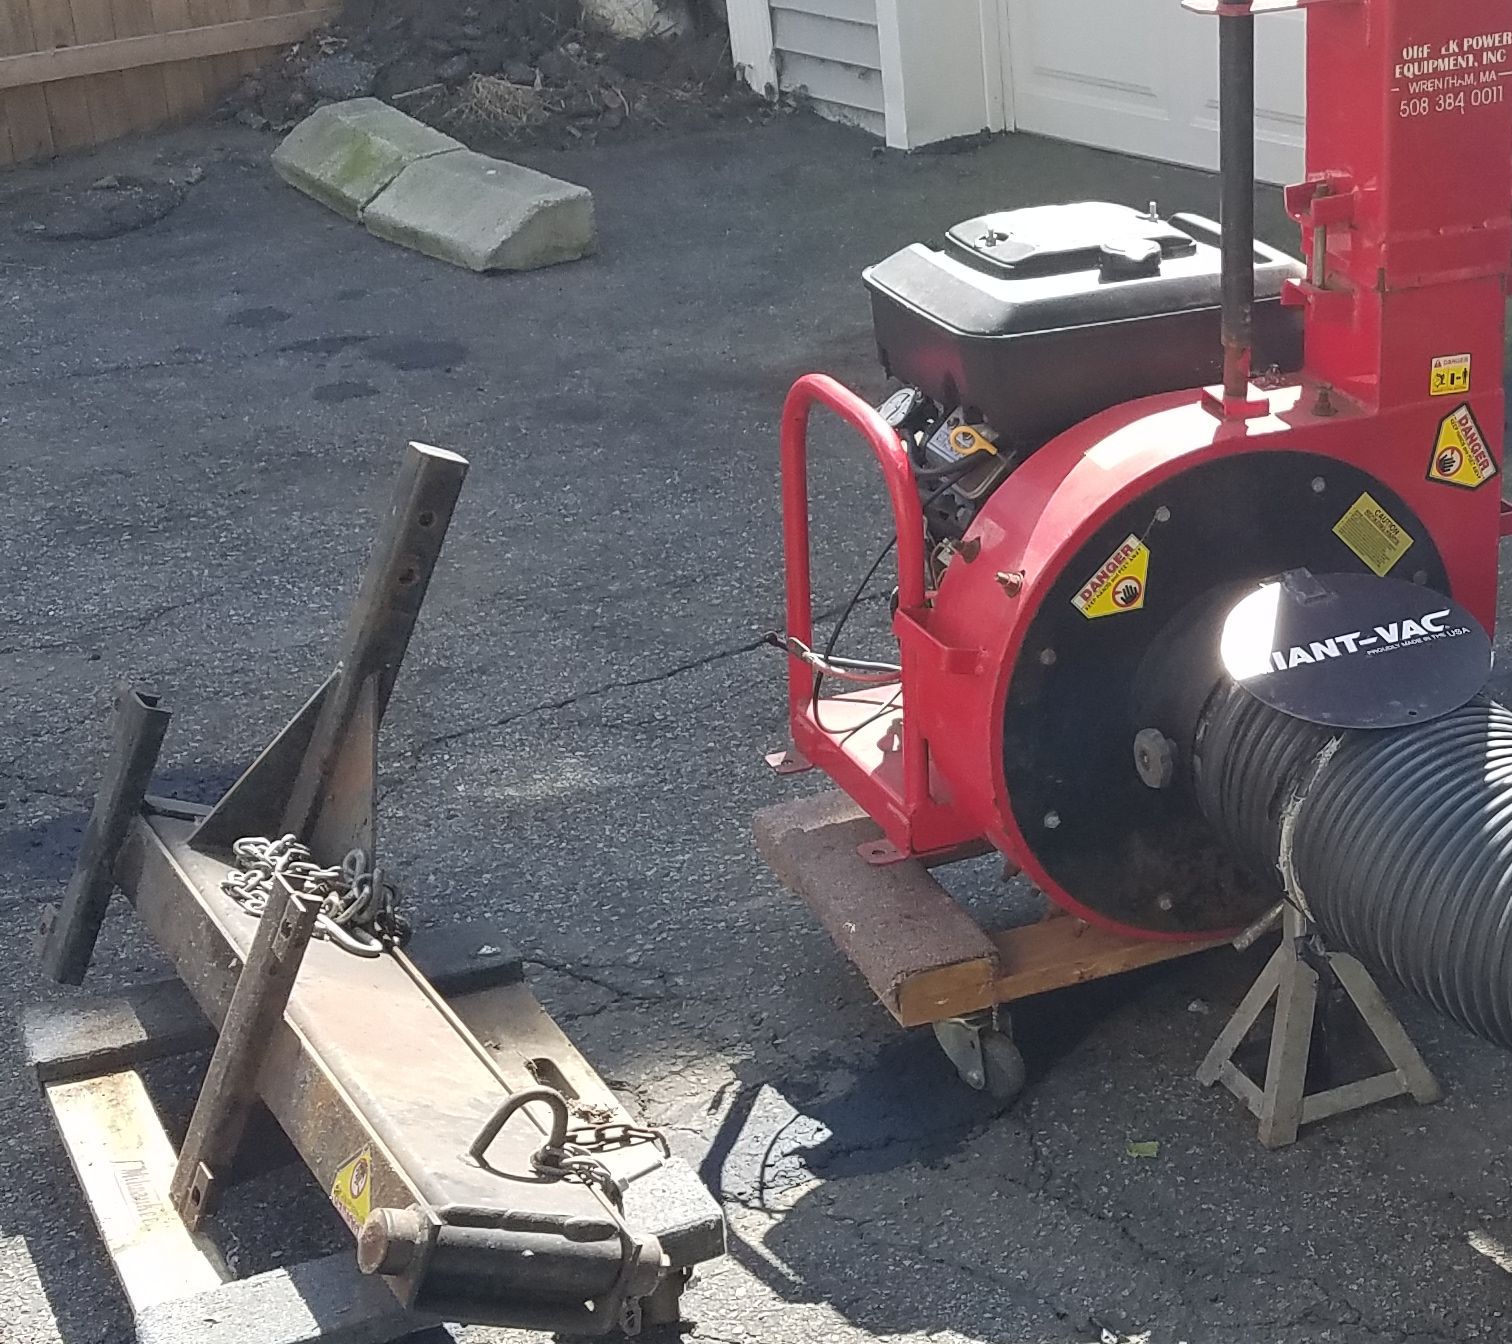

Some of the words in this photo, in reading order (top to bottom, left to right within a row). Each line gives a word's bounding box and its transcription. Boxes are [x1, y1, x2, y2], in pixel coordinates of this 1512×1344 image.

[1463, 31, 1512, 52] POWER
[1482, 48, 1507, 66] INC
[1479, 69, 1498, 83] MA
[1399, 97, 1429, 118] 508
[1435, 91, 1465, 115] 384
[1470, 85, 1503, 106] 0011
[1458, 414, 1490, 471] DANGER
[1374, 509, 1400, 536] CAUTION
[1080, 544, 1134, 602] DANGER
[1446, 626, 1471, 638] USA
